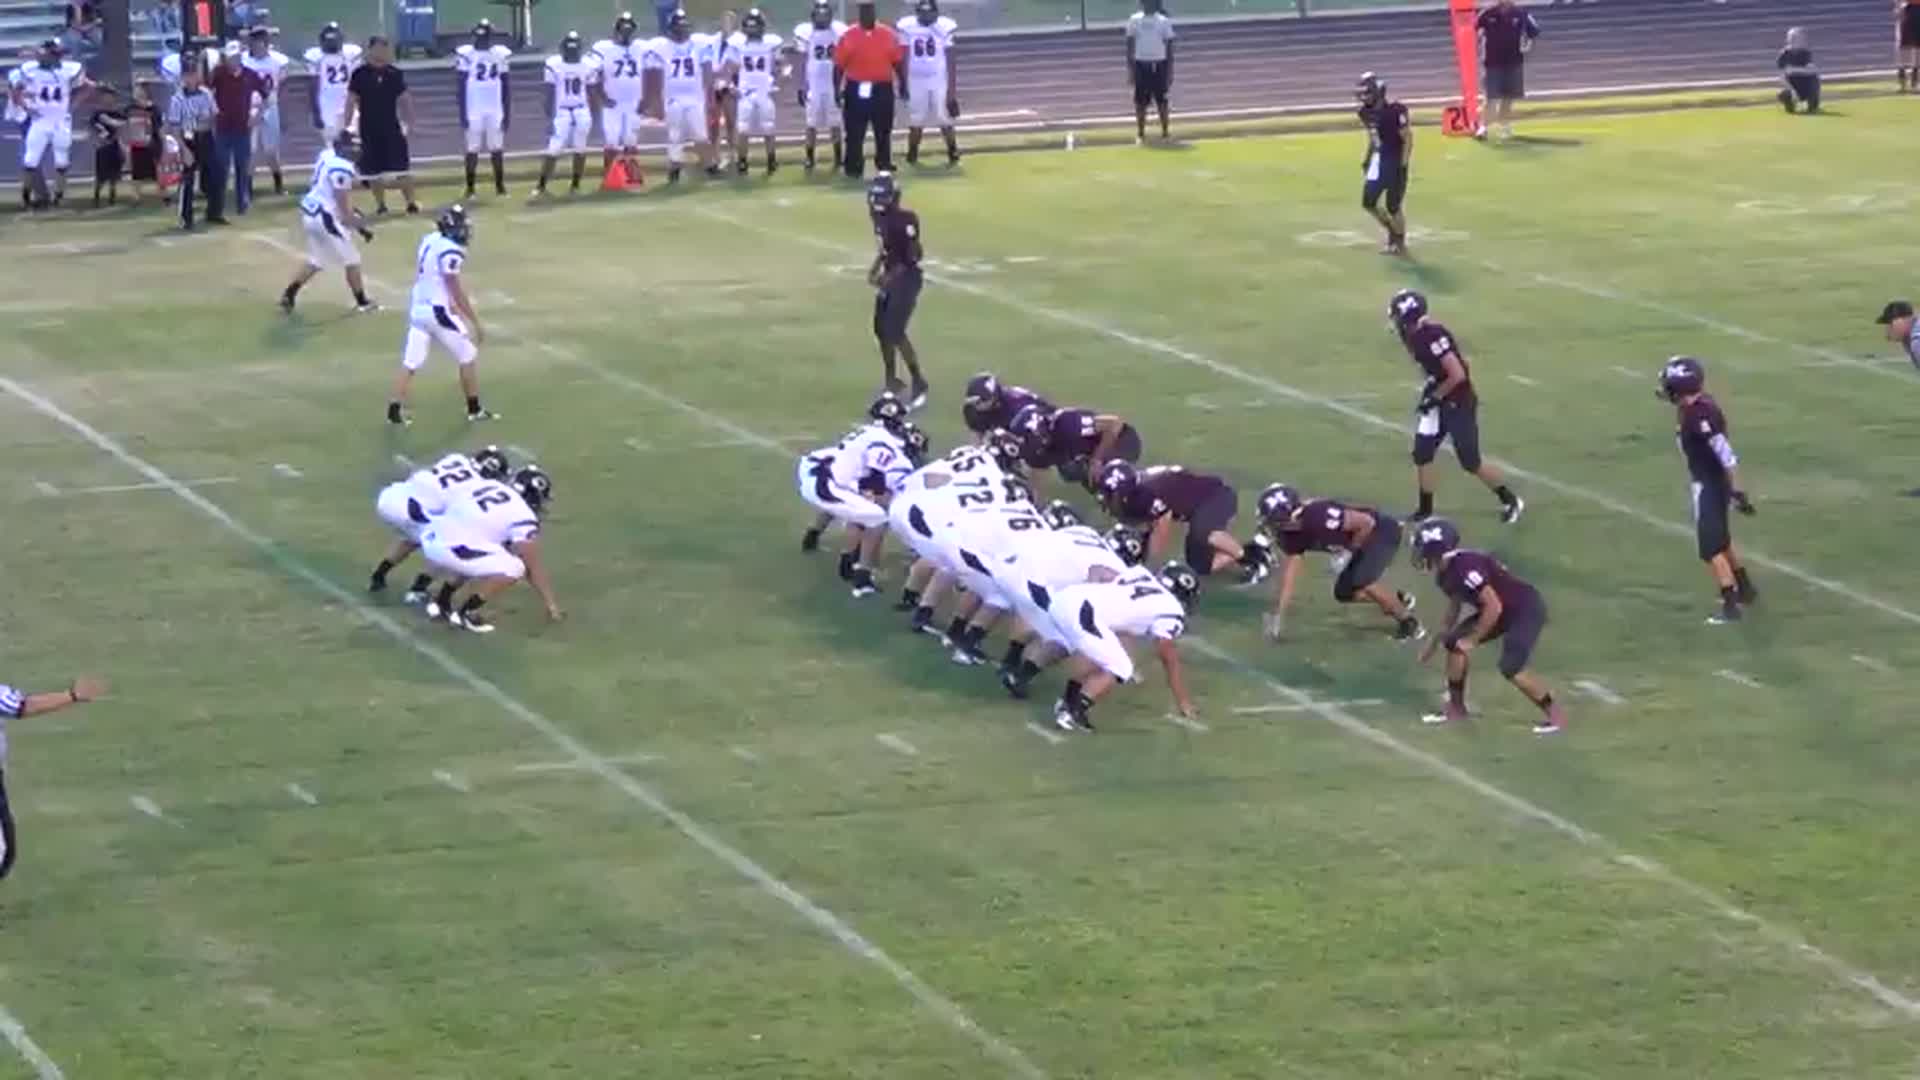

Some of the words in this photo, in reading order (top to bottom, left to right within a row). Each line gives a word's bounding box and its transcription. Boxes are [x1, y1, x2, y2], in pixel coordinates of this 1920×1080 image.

[326, 64, 349, 84] 23
[613, 59, 638, 78] 73
[40, 86, 63, 102] 44
[472, 485, 512, 513] 12
[952, 476, 995, 508] 72
